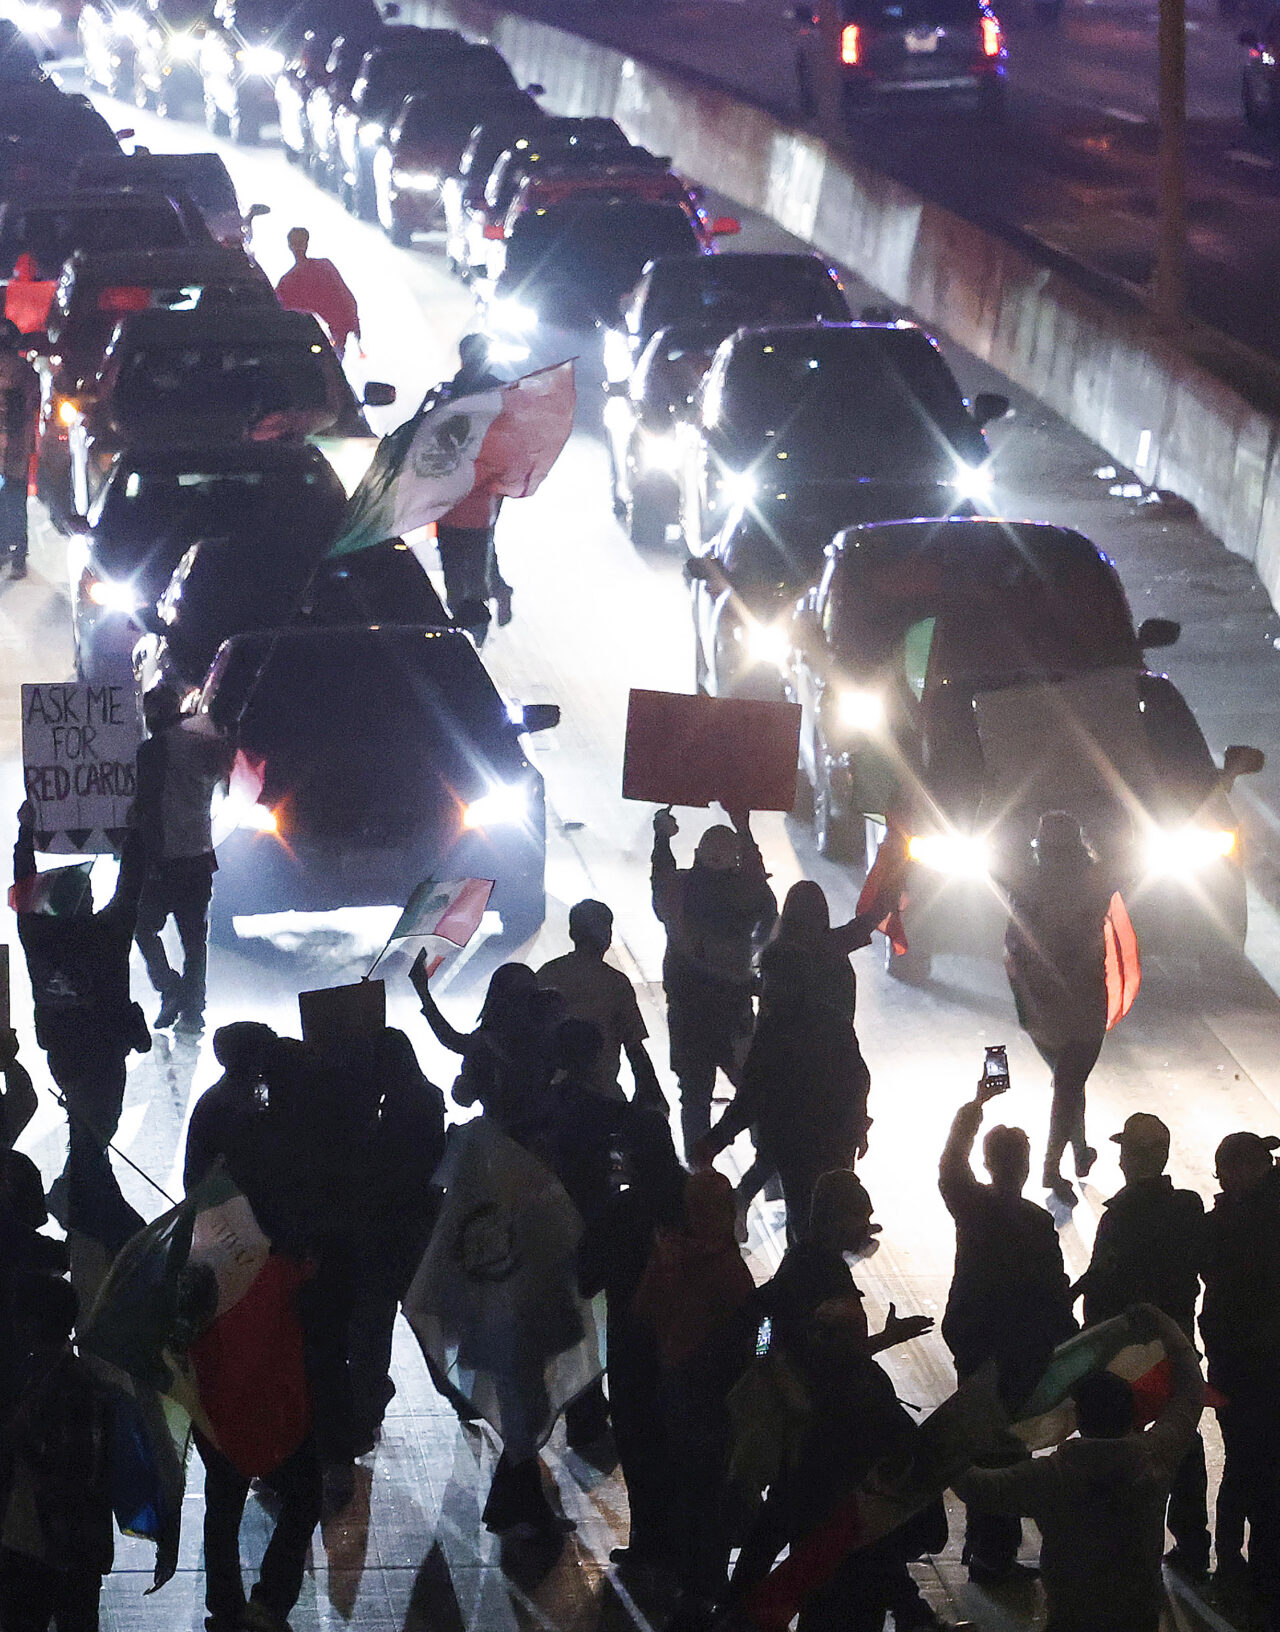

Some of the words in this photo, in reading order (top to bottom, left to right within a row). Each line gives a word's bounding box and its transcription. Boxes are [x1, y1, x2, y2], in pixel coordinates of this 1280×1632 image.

[25, 685, 80, 725] ASK
[86, 685, 124, 725] ME
[51, 725, 99, 760] FOR
[25, 764, 70, 801] RED
[74, 760, 138, 798] CARDS
